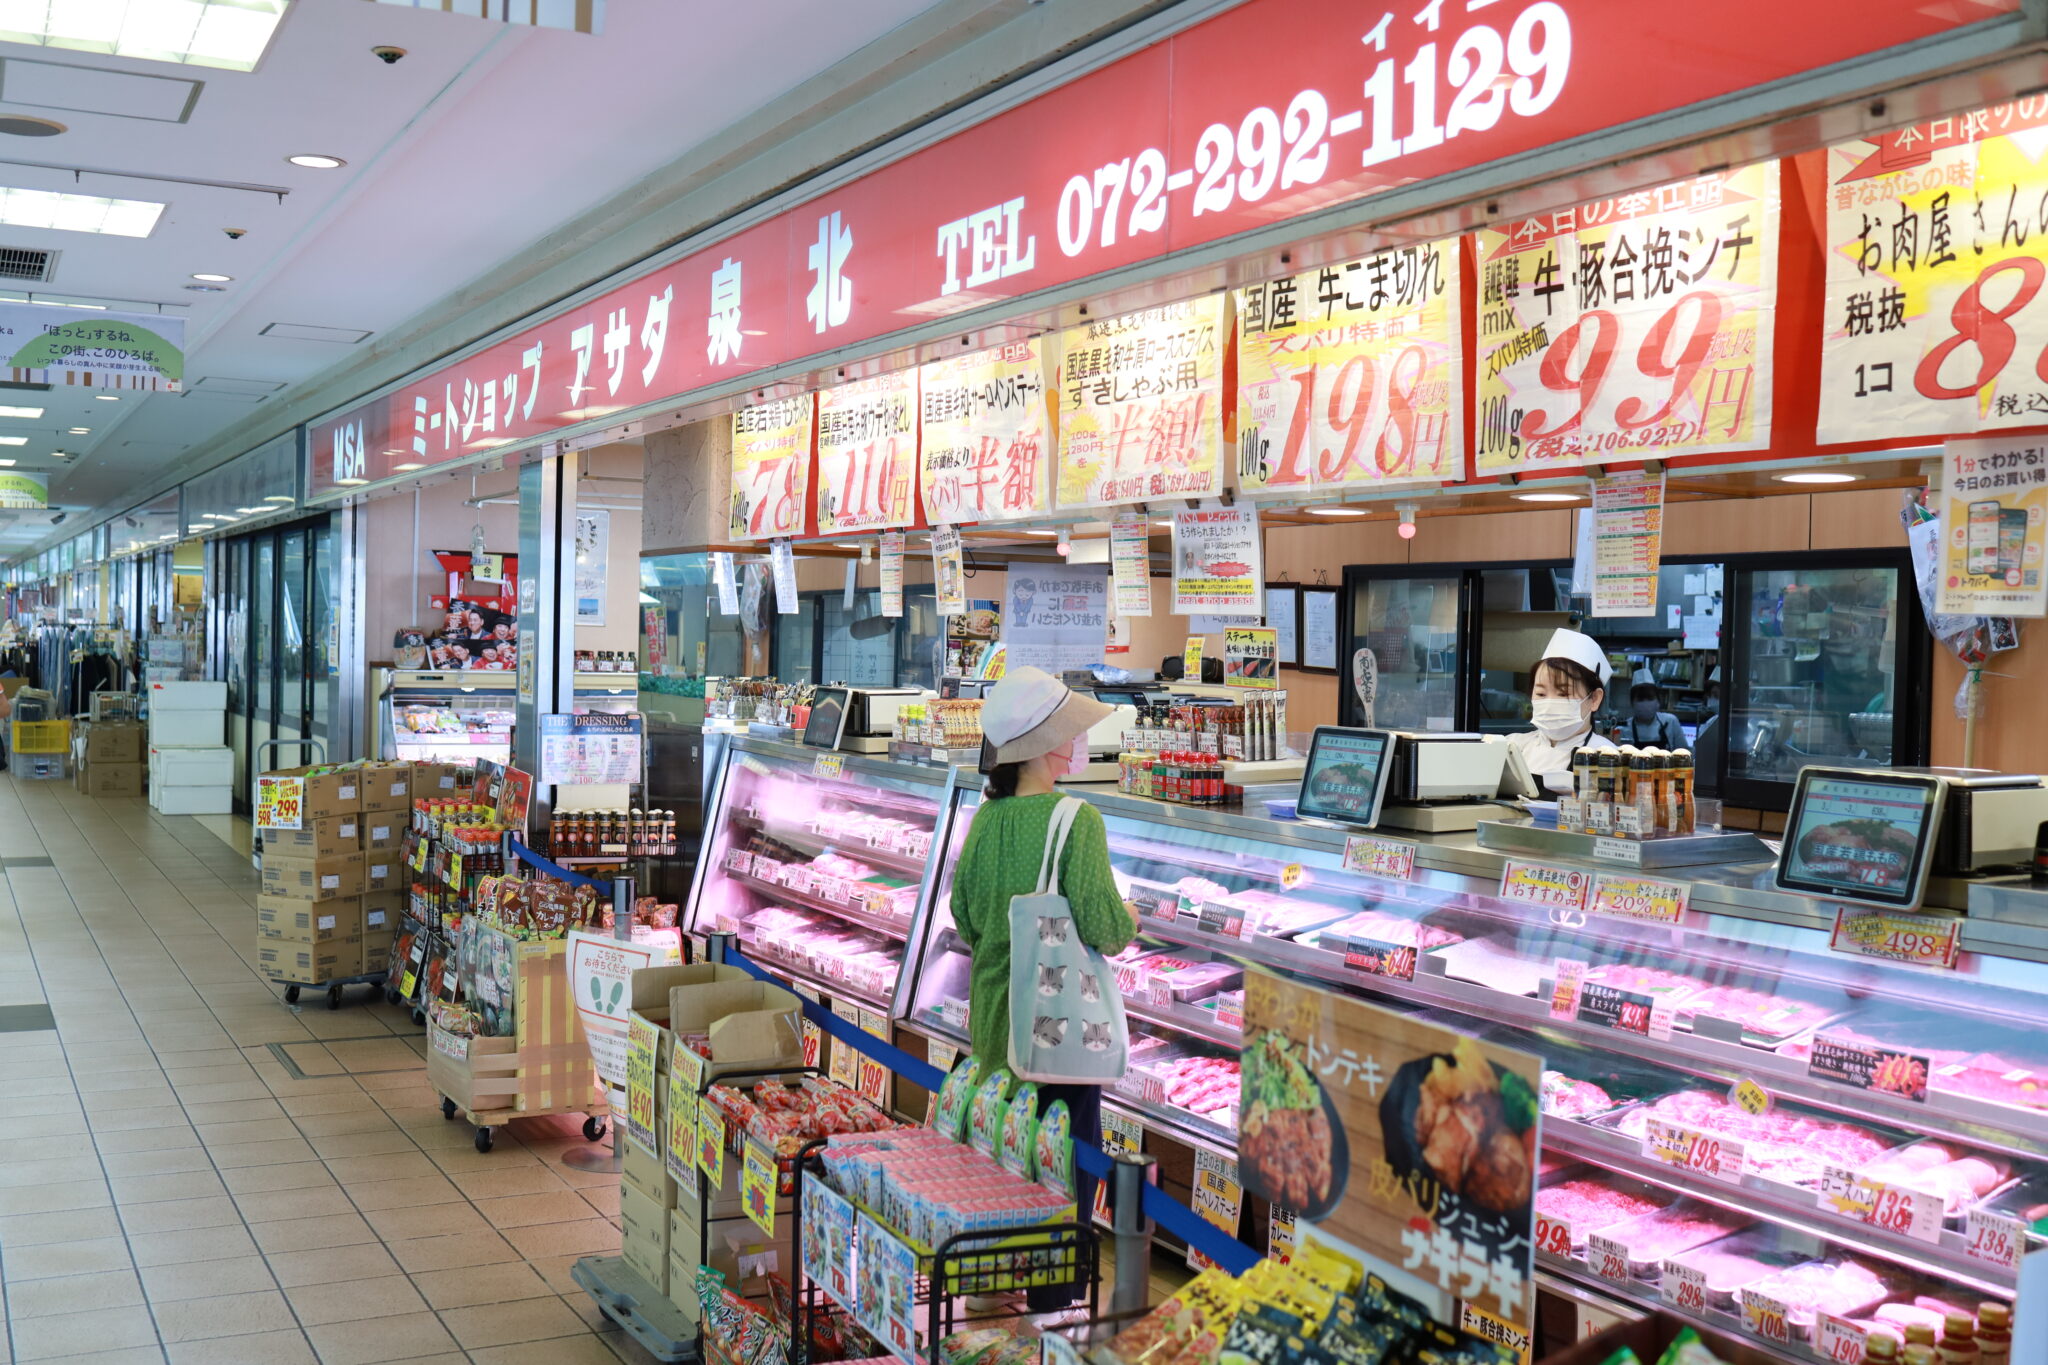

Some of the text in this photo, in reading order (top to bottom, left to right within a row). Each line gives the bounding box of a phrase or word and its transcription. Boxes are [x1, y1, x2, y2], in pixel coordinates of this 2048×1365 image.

[937, 0, 1572, 296] TEL 072-292-1129
[1834, 160, 1973, 211] 昔ながらの味
[1533, 214, 1754, 316] 牛・豚合挽ミンチ
[1243, 243, 1446, 337] 国産 牛こま切れ
[1483, 303, 1516, 336] mix
[1845, 285, 1907, 337] 税抜
[43, 324, 136, 343] 「ほっと」するね、
[1486, 321, 1549, 380] ズバリ特価
[49, 344, 160, 362] この街、このひろば。
[415, 340, 543, 456] ミートショップ
[571, 284, 673, 406] アサダ
[1066, 325, 1215, 382] 国産黒毛和牛肩ローススライス
[1068, 360, 1199, 410] すきしゃぶ用
[1854, 361, 1894, 398] 1コ
[1478, 394, 1524, 459] 100g
[333, 418, 366, 482] MSA
[1239, 427, 1270, 481] 100g
[1953, 447, 2045, 473] 1分でわかる!
[1953, 468, 2047, 492] 今日のお買い得
[730, 490, 750, 533] 100g
[818, 488, 836, 526] 100g
[1960, 576, 1989, 588] トクバイ
[546, 716, 627, 726] THE DRESSING
[258, 810, 271, 825] 598
[277, 799, 298, 817] 299
[1814, 841, 1900, 865] 国産若鶏もも肉
[1513, 881, 1578, 907] おすすめ品
[1635, 882, 1682, 902] 今ならお得!
[1858, 865, 1889, 887] 78
[597, 950, 625, 963] こちらで
[860, 1061, 884, 1100] 198
[1308, 1033, 1385, 1098] トンテキ
[673, 1120, 695, 1164] ¥90
[1111, 1130, 1126, 1145] 国産
[1648, 1135, 1689, 1154] 牛こま切れ
[1667, 1129, 1685, 1143] 国産
[1207, 1172, 1226, 1194] 国産
[1369, 1158, 1441, 1219] 皮パリ
[1821, 1178, 1874, 1207] ロースハム
[1194, 1184, 1238, 1225] 牛ヘレステーキ
[1439, 1191, 1531, 1252] ジューシー
[1462, 1307, 1531, 1353] 牛・豚合挽ミンチ
